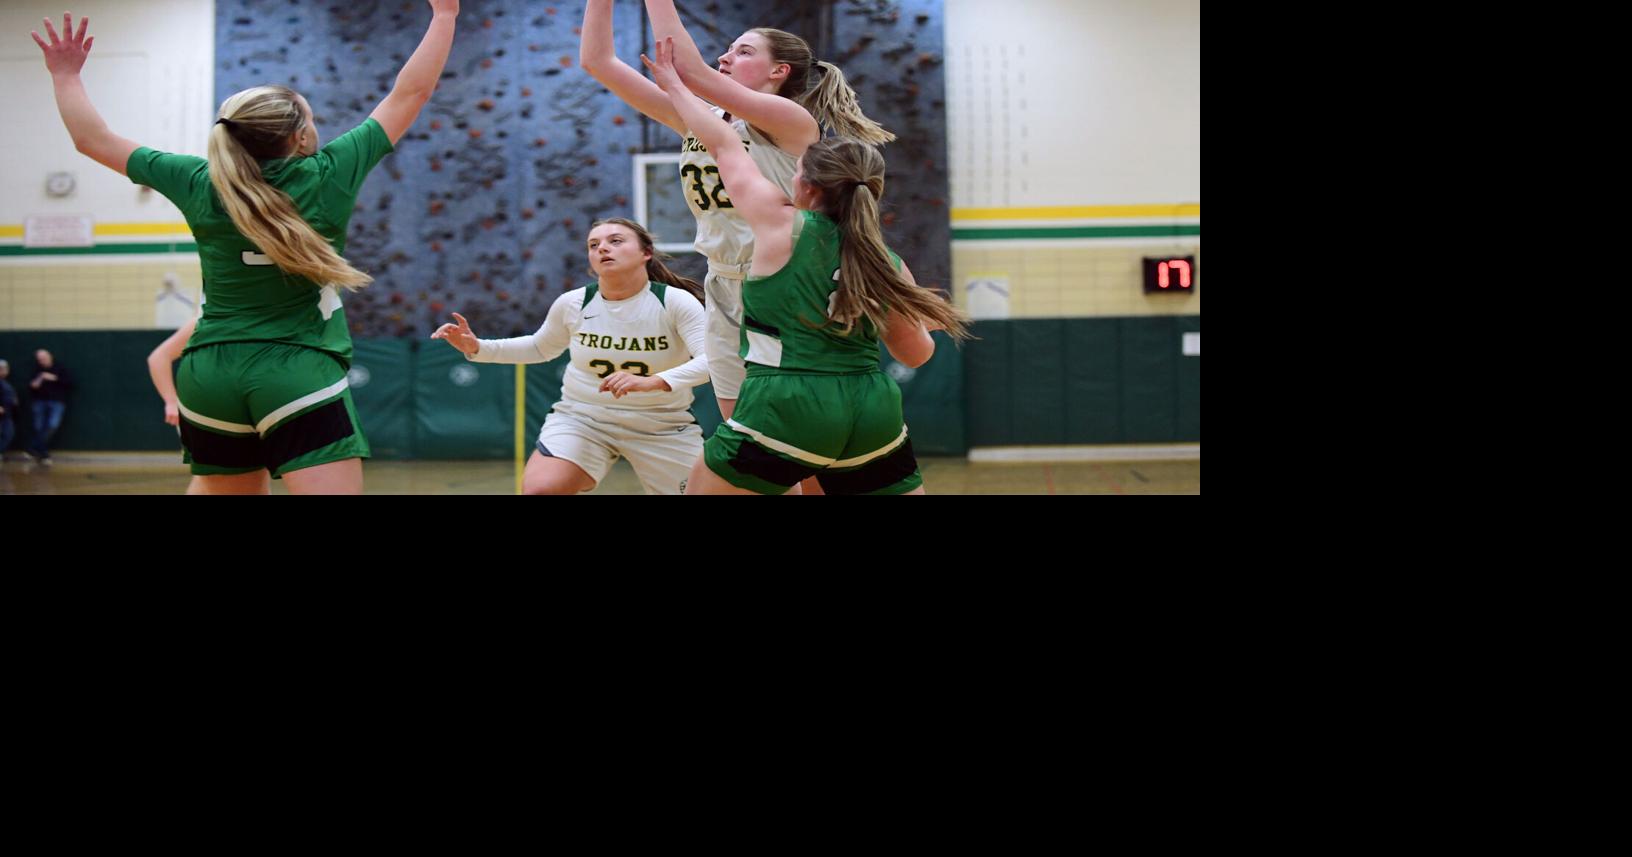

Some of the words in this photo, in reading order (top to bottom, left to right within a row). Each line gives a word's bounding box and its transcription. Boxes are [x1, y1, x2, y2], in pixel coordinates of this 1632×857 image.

[681, 164, 734, 210] 32
[1158, 260, 1190, 288] 17
[577, 332, 669, 351] TROJANS
